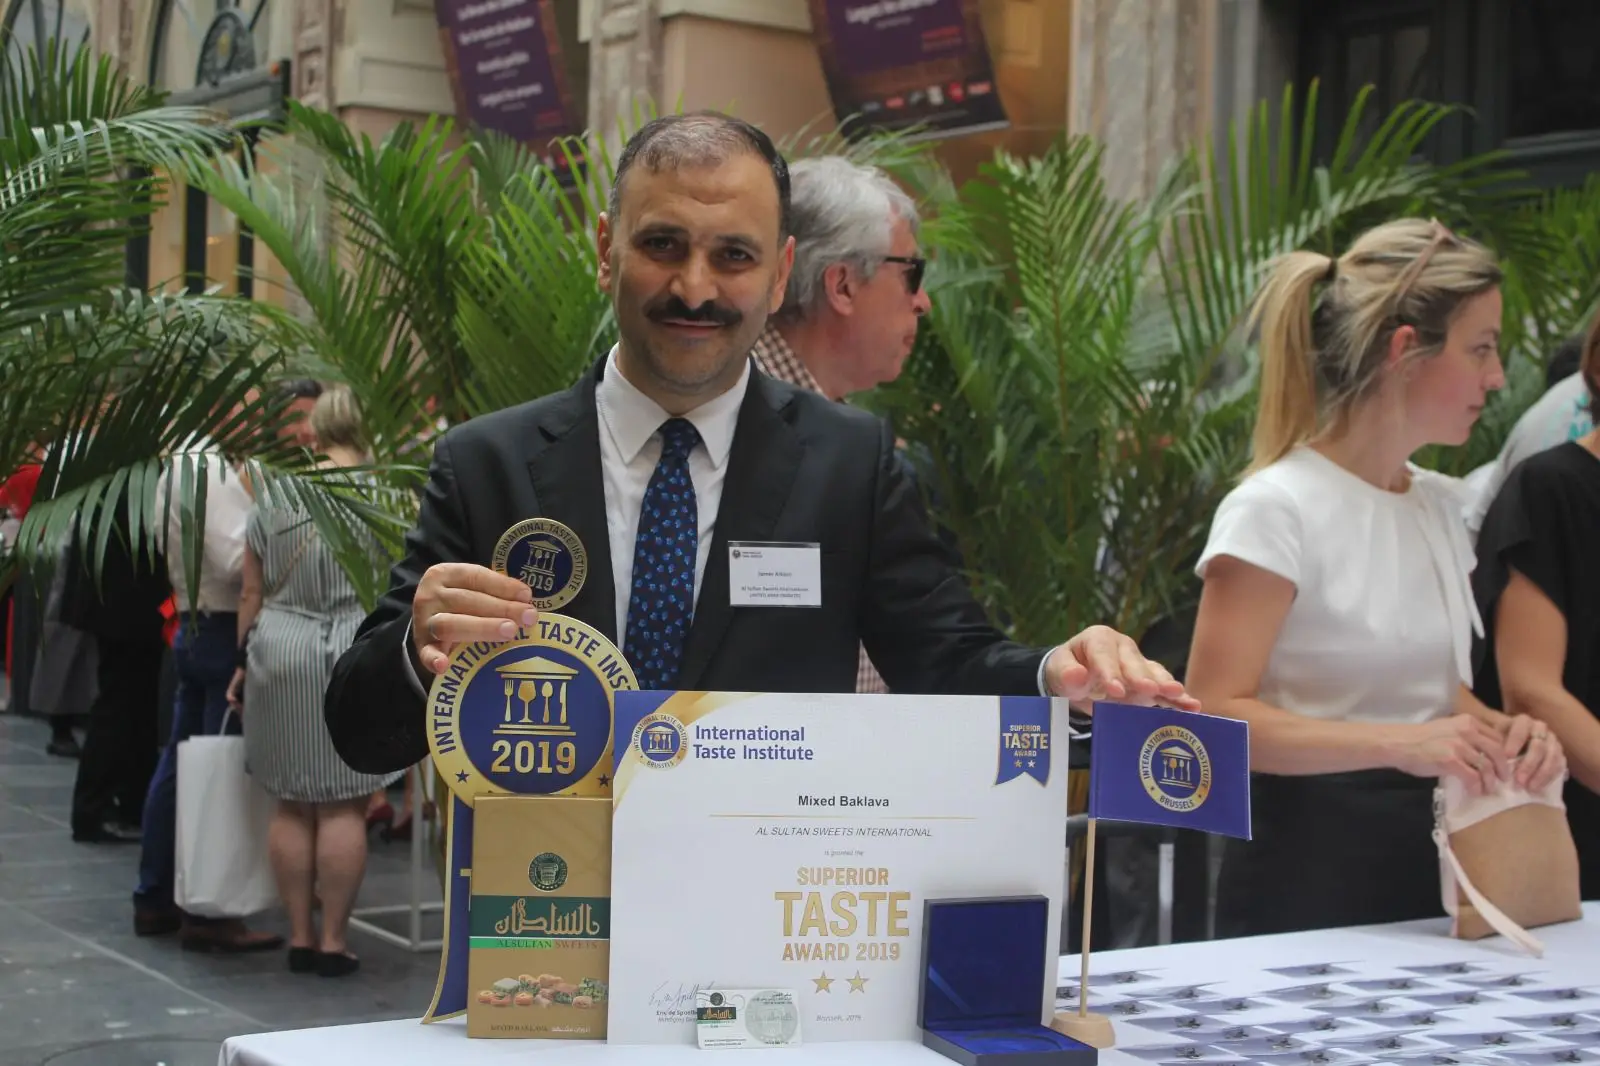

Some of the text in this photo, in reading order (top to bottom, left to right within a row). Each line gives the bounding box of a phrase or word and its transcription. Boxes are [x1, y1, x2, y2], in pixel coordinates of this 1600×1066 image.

[495, 522, 585, 592] INTERNATIONAL TASTE INSTITUTE
[519, 570, 554, 592] 2019
[530, 600, 553, 609] SELS
[433, 626, 530, 755] INTERNATIOL
[538, 620, 601, 658] TASTE
[633, 715, 659, 751] INTERNATIONAL
[660, 714, 677, 725] TASTE
[695, 725, 805, 742] International
[1009, 724, 1041, 732] SUPERIOR
[1002, 732, 1049, 750] TASTE
[491, 739, 577, 775] 2019
[692, 744, 814, 761] Taste Institute
[1142, 728, 1209, 788] INTERNATIONAL TASTE INSTITUTE
[798, 795, 890, 808] Mixed Baklava
[1159, 795, 1195, 809] BRUSSELS
[755, 827, 932, 837] AL SULTAN SWEETS INTERNATIONAL
[796, 867, 889, 886] SUPERIOR
[774, 890, 911, 937] TASTE
[496, 940, 598, 949] ALSULTAN SWEETS
[782, 942, 901, 961] AWARD 2019
